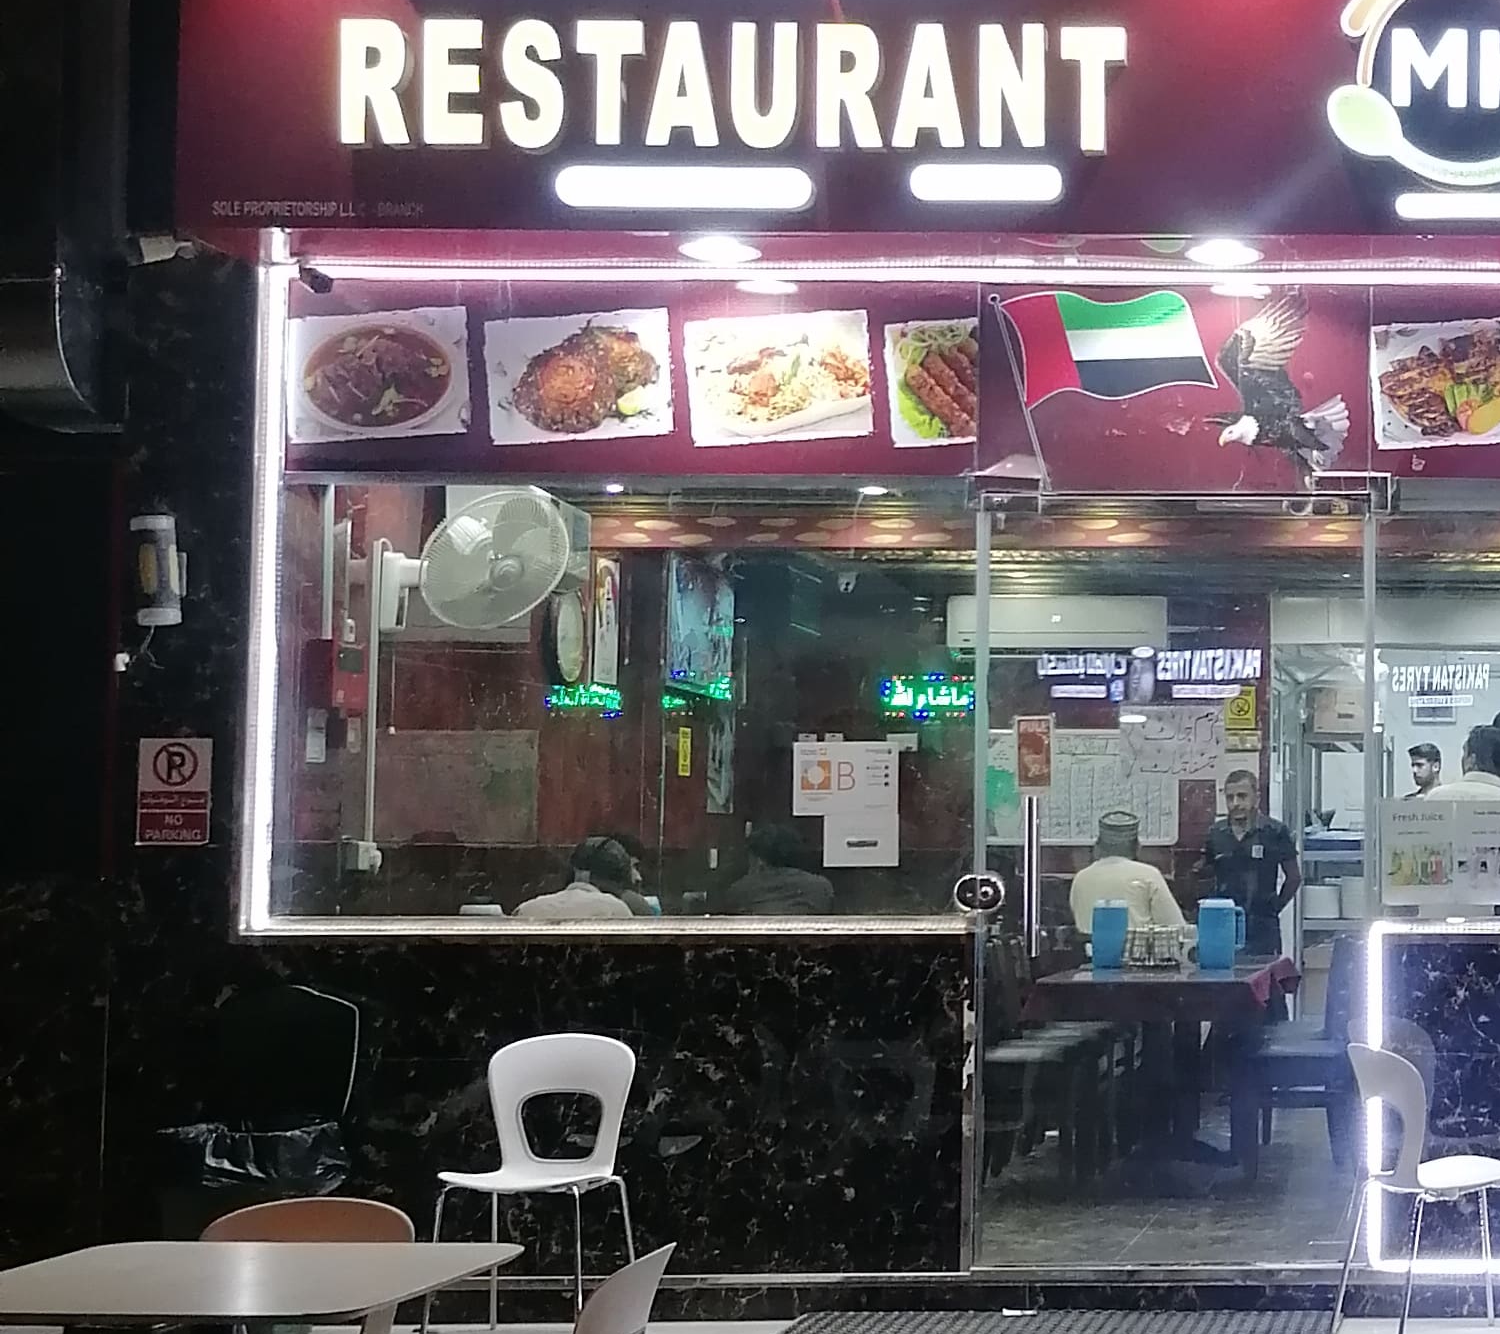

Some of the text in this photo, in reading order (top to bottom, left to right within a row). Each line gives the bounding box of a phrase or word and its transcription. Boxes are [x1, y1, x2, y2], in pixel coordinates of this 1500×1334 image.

[338, 18, 1128, 154] RESTAURANT
[212, 200, 241, 216] SOLE
[243, 200, 338, 217] PROPRIETORSHIP
[837, 761, 856, 791] B
[164, 814, 184, 826] NO
[145, 829, 202, 841] PARKING
